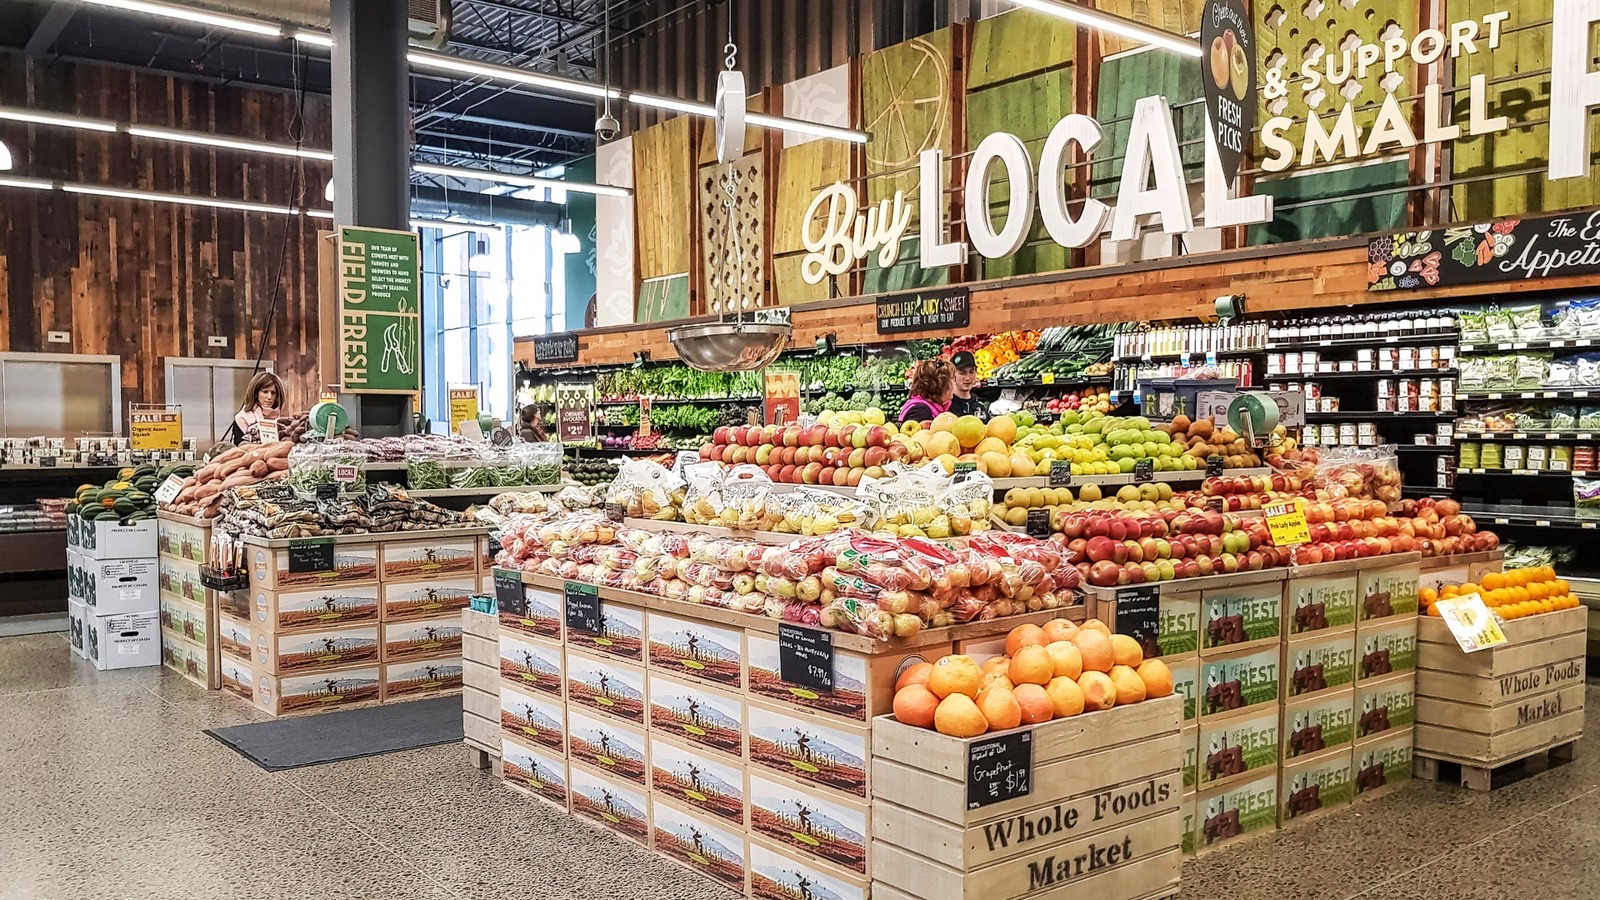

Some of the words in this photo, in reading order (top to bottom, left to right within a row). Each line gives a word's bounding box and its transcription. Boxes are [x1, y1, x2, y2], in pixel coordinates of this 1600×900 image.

[1262, 66, 1289, 99] &
[1301, 11, 1510, 91] SUPPORT
[1218, 95, 1242, 128] FRESH
[1260, 74, 1509, 172] SMALL
[1217, 124, 1242, 153] PICKS
[801, 180, 914, 285] Buy
[920, 95, 1274, 270] LOCAL
[1548, 219, 1577, 238] The
[343, 241, 366, 304] FIELD
[920, 298, 940, 316] JUICY
[943, 296, 966, 312] SWEET
[344, 313, 368, 384] FRESH
[451, 390, 473, 399] SALE!
[133, 414, 162, 423] SALE!
[338, 467, 355, 478] LOCAL
[1264, 504, 1287, 518] SALE!
[1323, 589, 1355, 608] BEST
[1388, 579, 1418, 598] BEST
[304, 606, 329, 614] FIELD
[331, 602, 357, 612] FRESH
[1242, 600, 1279, 620] BEST
[304, 648, 329, 656] FIELD
[331, 644, 357, 653] FRESH
[693, 647, 719, 663] FRESH
[1387, 635, 1416, 654] BEST
[1322, 648, 1353, 669] BEST
[1240, 663, 1277, 686] BEST
[1500, 672, 1540, 697] Whole
[1545, 661, 1582, 686] Foods
[305, 689, 330, 698] FIELD
[331, 684, 358, 694] FRESH
[1385, 691, 1414, 711] BEST
[1320, 707, 1352, 730] BEST
[1516, 691, 1563, 726] Market
[694, 711, 720, 730] FRESH
[1241, 727, 1277, 750] BEST
[774, 738, 800, 756] FIELD
[803, 746, 836, 768] FRESH
[1382, 746, 1412, 767] BEST
[973, 760, 1016, 781] Grapefruit
[1318, 766, 1350, 789] BEST
[1238, 789, 1275, 814] BEST
[774, 809, 800, 828] FIELD
[804, 819, 837, 843] FRESH
[983, 805, 1079, 852] Whole
[1091, 780, 1171, 822] Foods
[1026, 834, 1133, 891] Market
